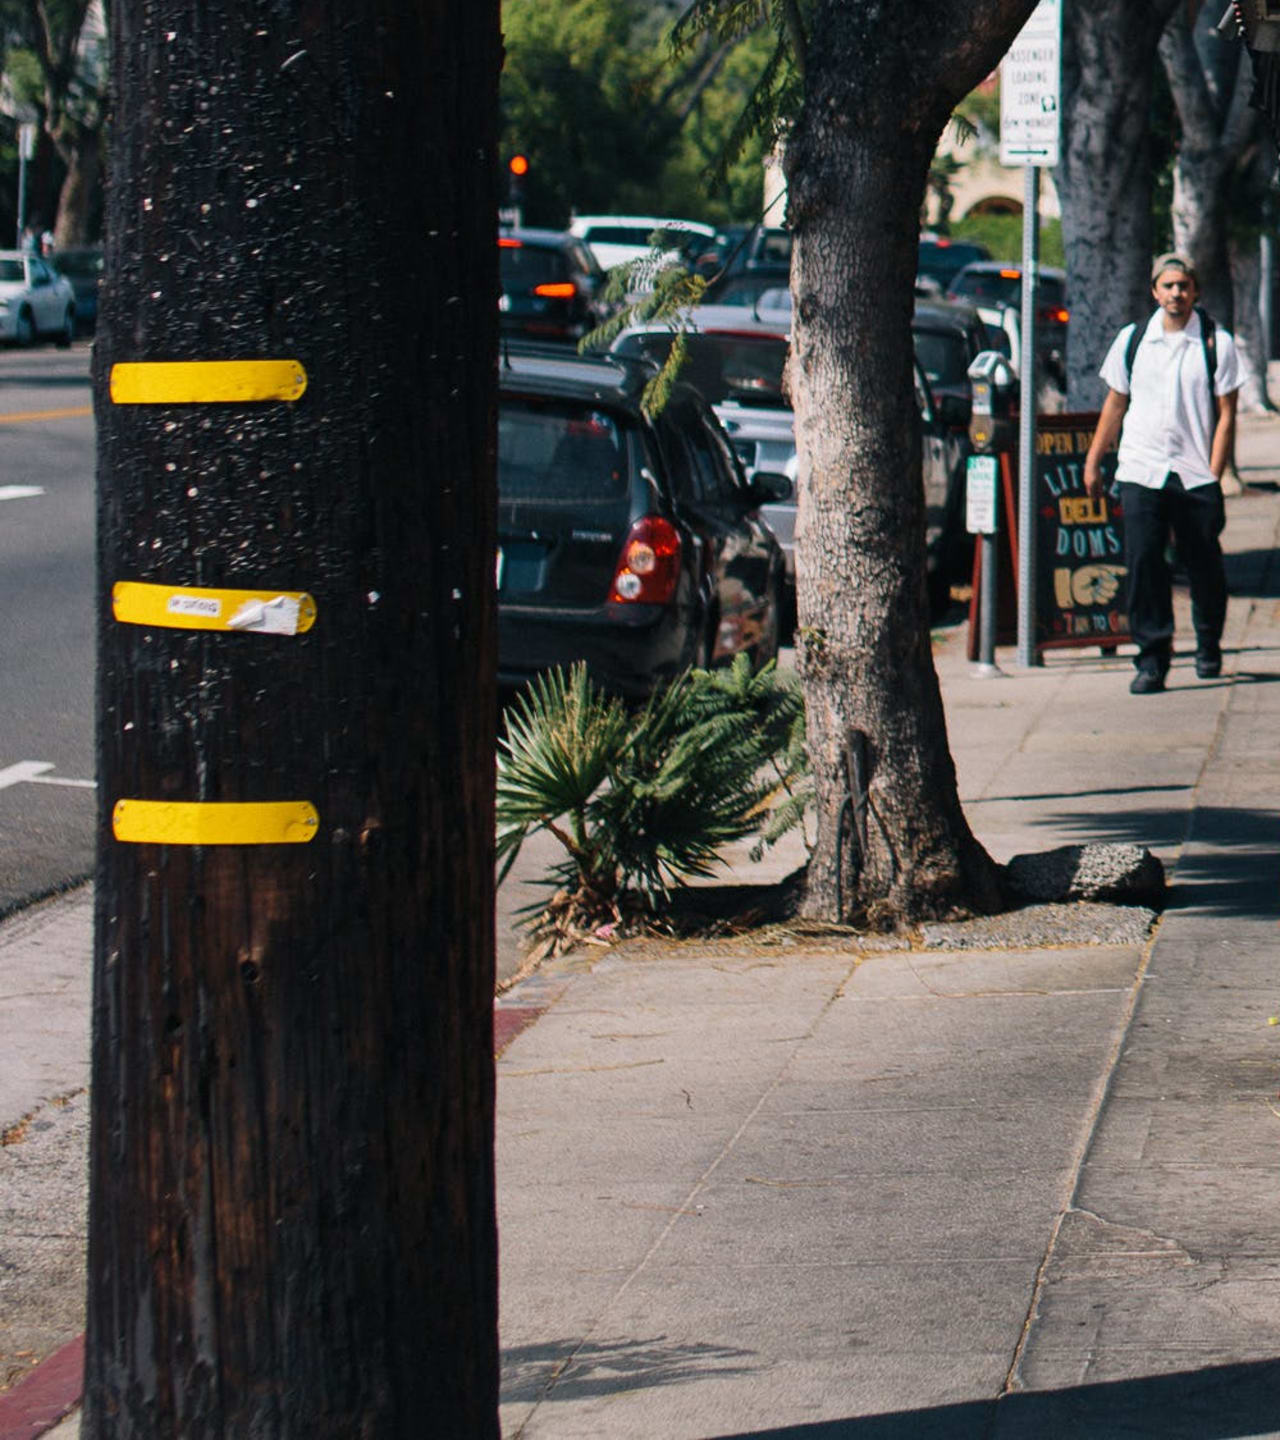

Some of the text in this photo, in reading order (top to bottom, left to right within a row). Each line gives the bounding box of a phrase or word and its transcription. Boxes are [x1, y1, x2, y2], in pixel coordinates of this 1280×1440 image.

[1011, 69, 1048, 85] LOADING
[1036, 432, 1073, 455] OPEN
[1058, 497, 1108, 525] DELI
[1056, 526, 1122, 558] DOMS
